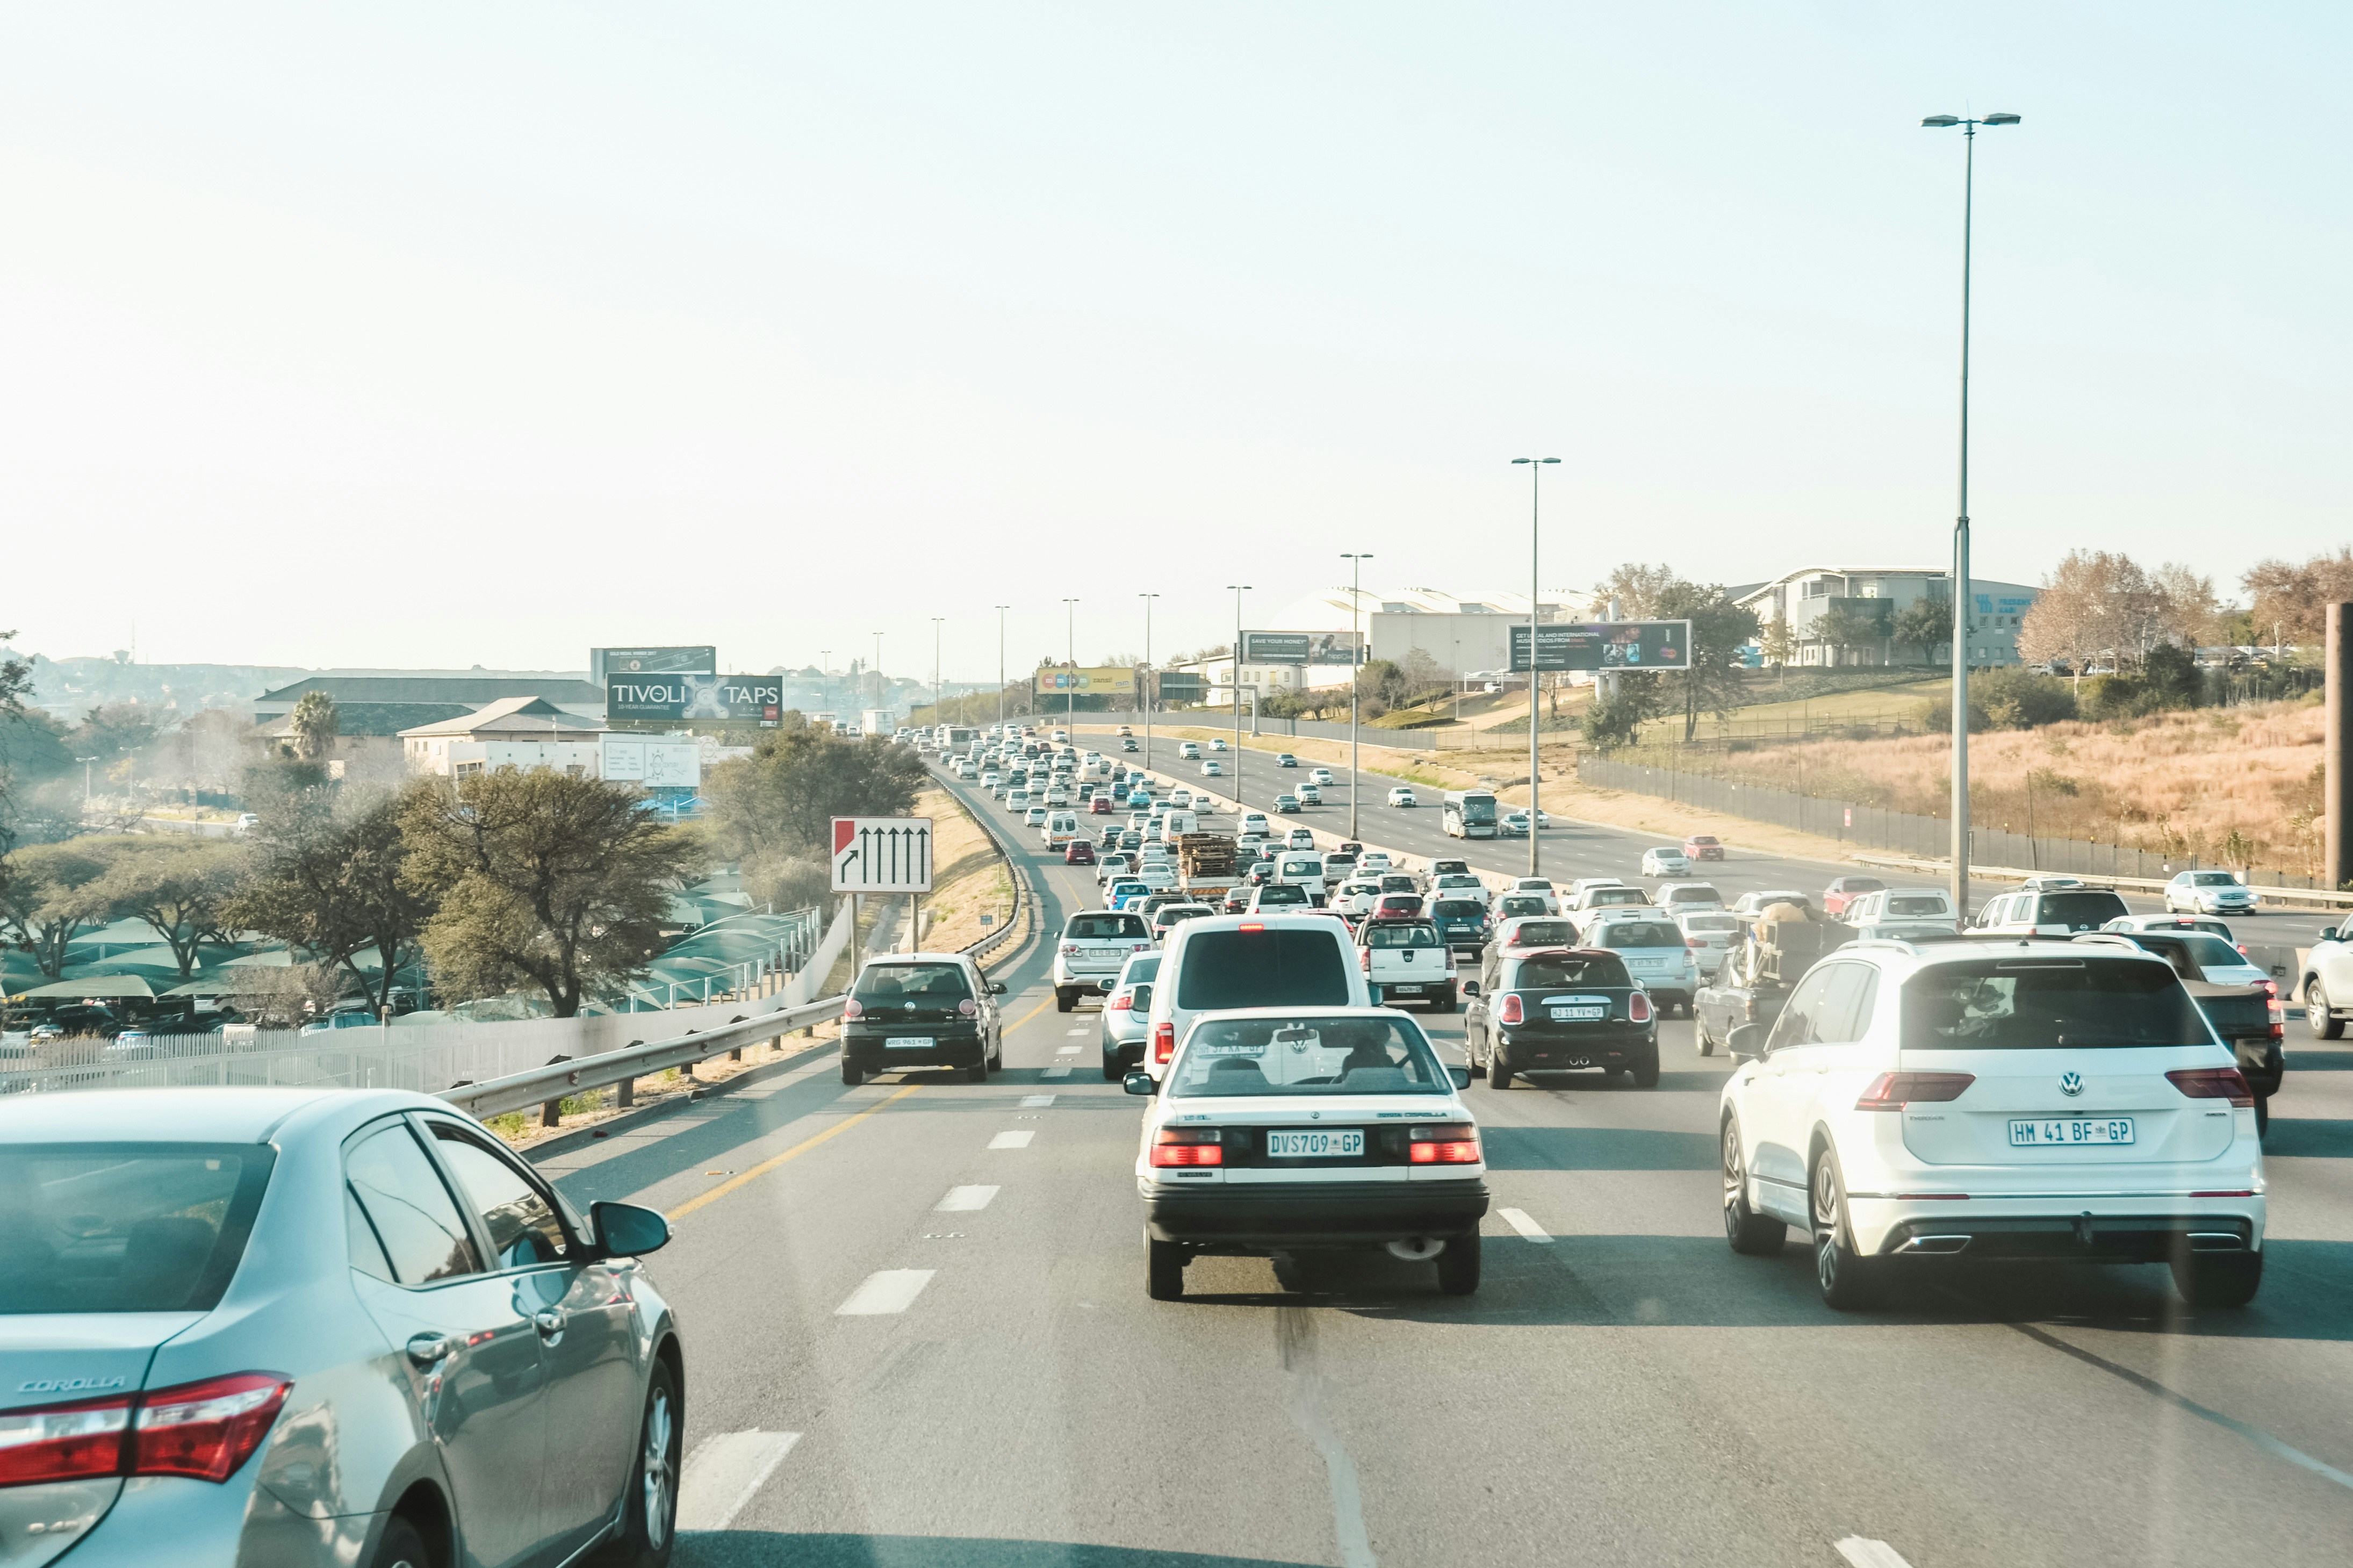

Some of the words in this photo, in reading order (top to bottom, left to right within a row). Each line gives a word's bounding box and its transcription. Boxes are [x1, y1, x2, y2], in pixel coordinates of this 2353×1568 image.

[611, 685, 686, 703] TIVOLI
[723, 687, 779, 704] TAPS
[1552, 1009, 1562, 1017] HJ
[1565, 1009, 1573, 1017] 11
[2014, 1124, 2035, 1142] HM
[2045, 1123, 2064, 1141] 41
[2072, 1122, 2092, 1141] BF
[2109, 1121, 2128, 1140] GP
[1271, 1135, 1328, 1153] DVS709
[1343, 1134, 1361, 1152] GP
[18, 1375, 126, 1392] COROLLA
